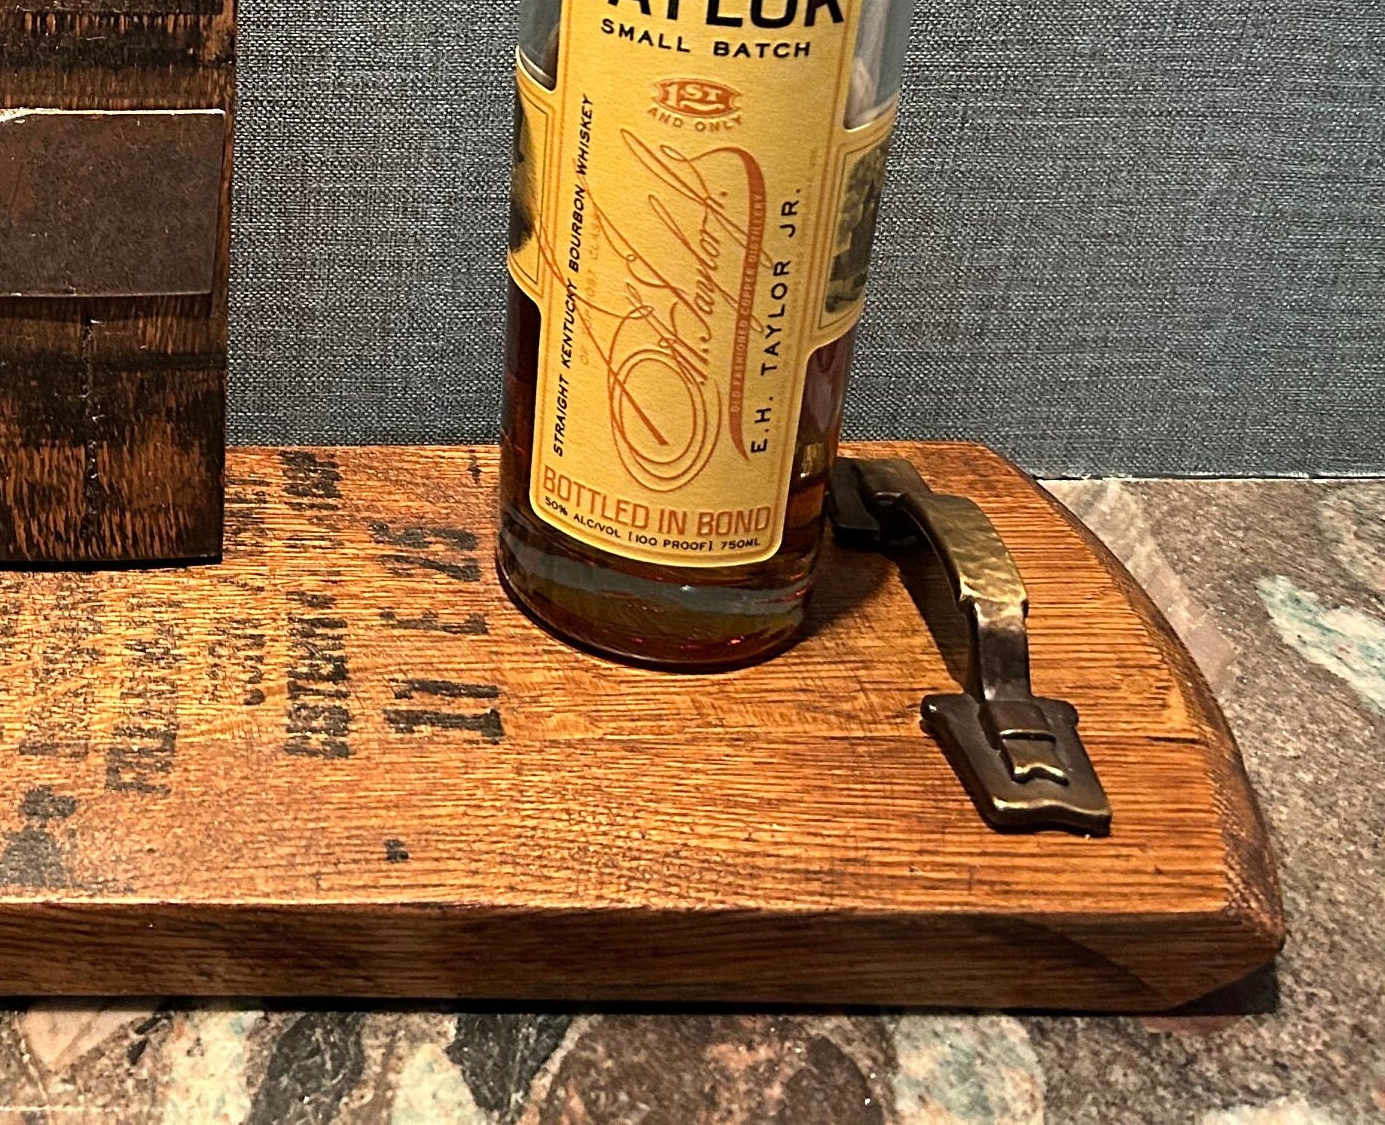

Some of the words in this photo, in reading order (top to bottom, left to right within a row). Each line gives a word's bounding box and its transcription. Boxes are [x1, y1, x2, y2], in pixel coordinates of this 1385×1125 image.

[600, 17, 692, 54] SMALL
[712, 40, 812, 59] BATCH
[574, 92, 595, 178] WHISKEY
[645, 106, 684, 129] AND
[694, 114, 743, 133] ONLY
[567, 183, 586, 274] BOURBON
[778, 186, 801, 240] JR.
[739, 268, 756, 316] COPPER
[760, 258, 792, 377] TAYLOR
[559, 278, 579, 370] KENTUCKY
[732, 318, 749, 386] FASHIONED
[551, 373, 571, 458] STRAIGHT
[730, 388, 743, 414] OLD
[750, 396, 774, 455] E.H.
[541, 464, 651, 531] BOTTLED
[657, 506, 688, 537] IN
[695, 505, 774, 538] BOND
[543, 495, 569, 517] 50%
[572, 513, 622, 539] ALC/VOL
[720, 536, 762, 551] 750ML
